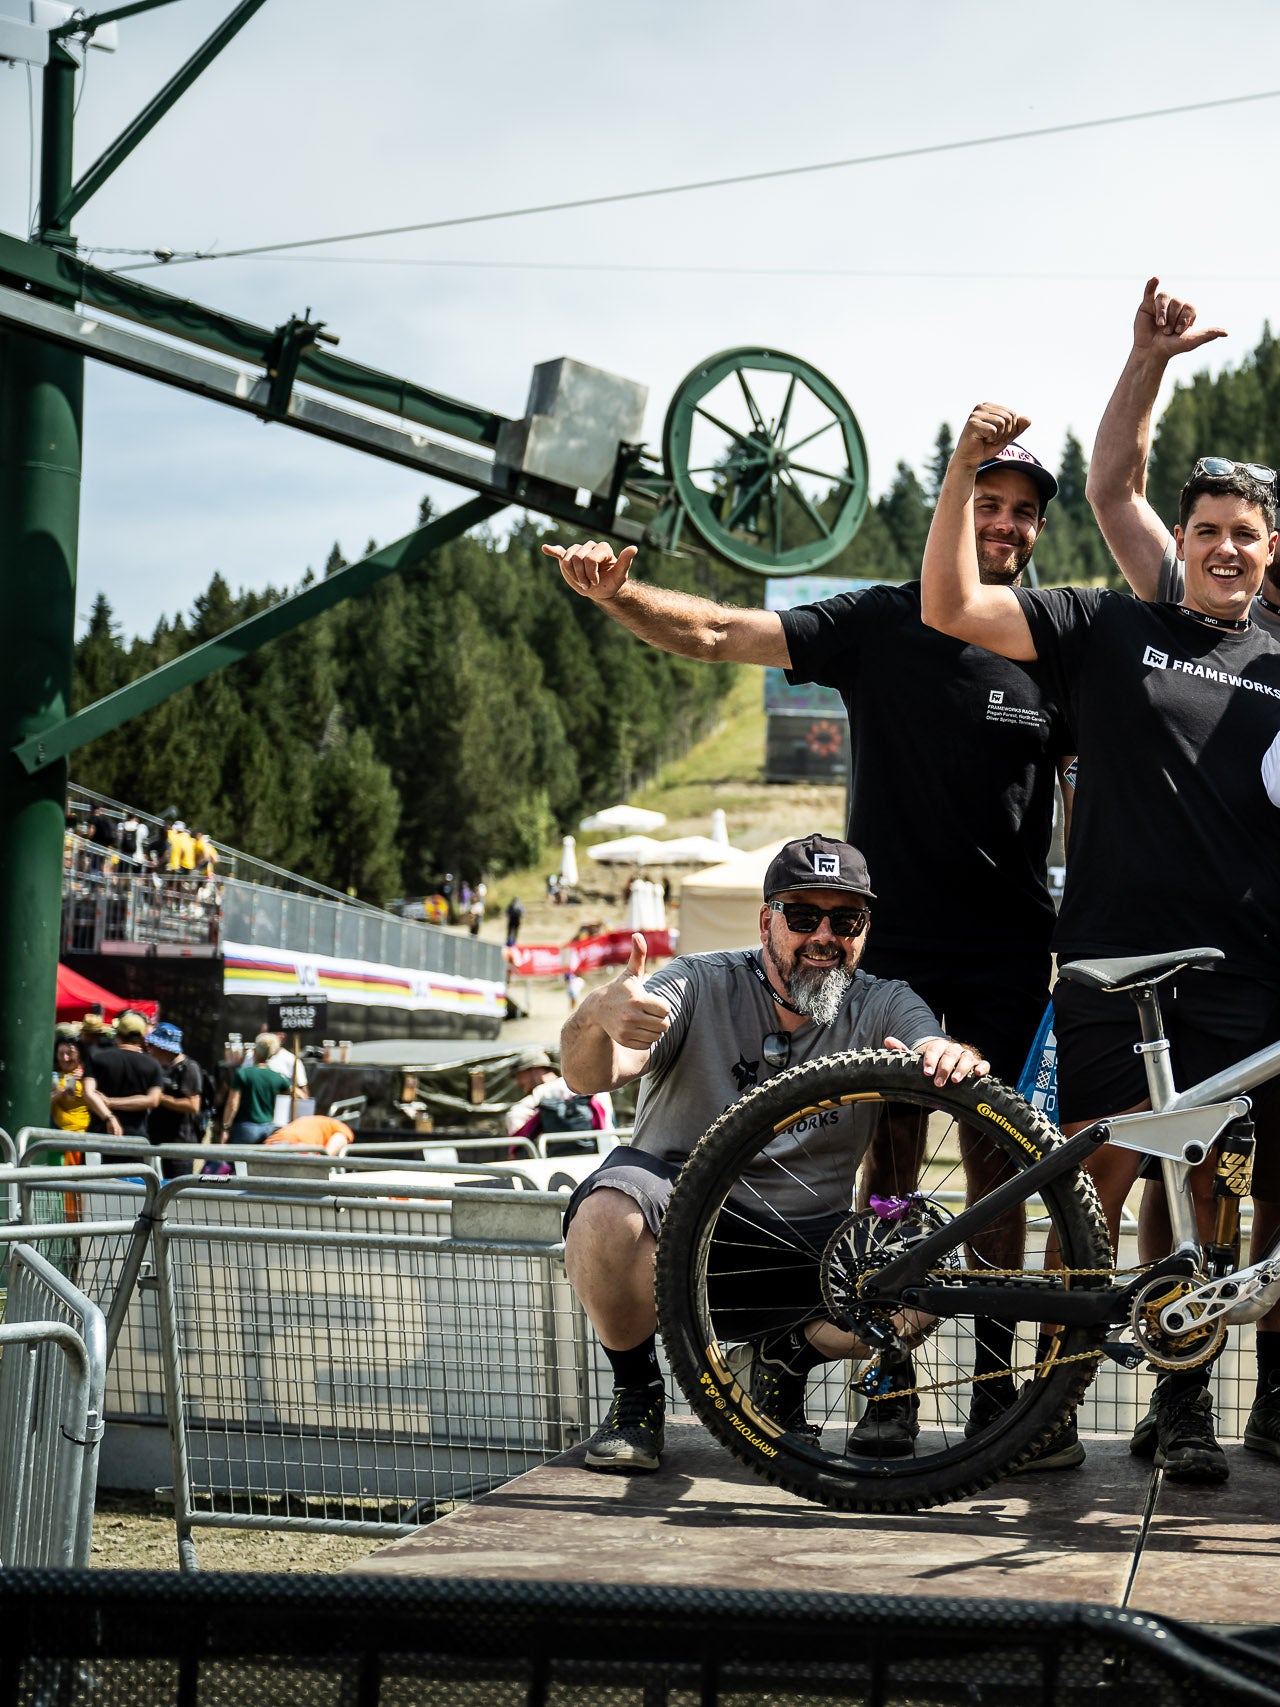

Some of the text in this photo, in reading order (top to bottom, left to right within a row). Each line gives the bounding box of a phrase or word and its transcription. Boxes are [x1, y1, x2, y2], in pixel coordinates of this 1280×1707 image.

[1206, 617, 1218, 625] UCI
[988, 704, 1038, 716] FRAMEWORKS RACING
[280, 1006, 316, 1018] PRESS
[282, 1016, 314, 1028] ZONE
[976, 1102, 1037, 1157] Continental
[728, 1414, 778, 1458] KRYPTOTAL
